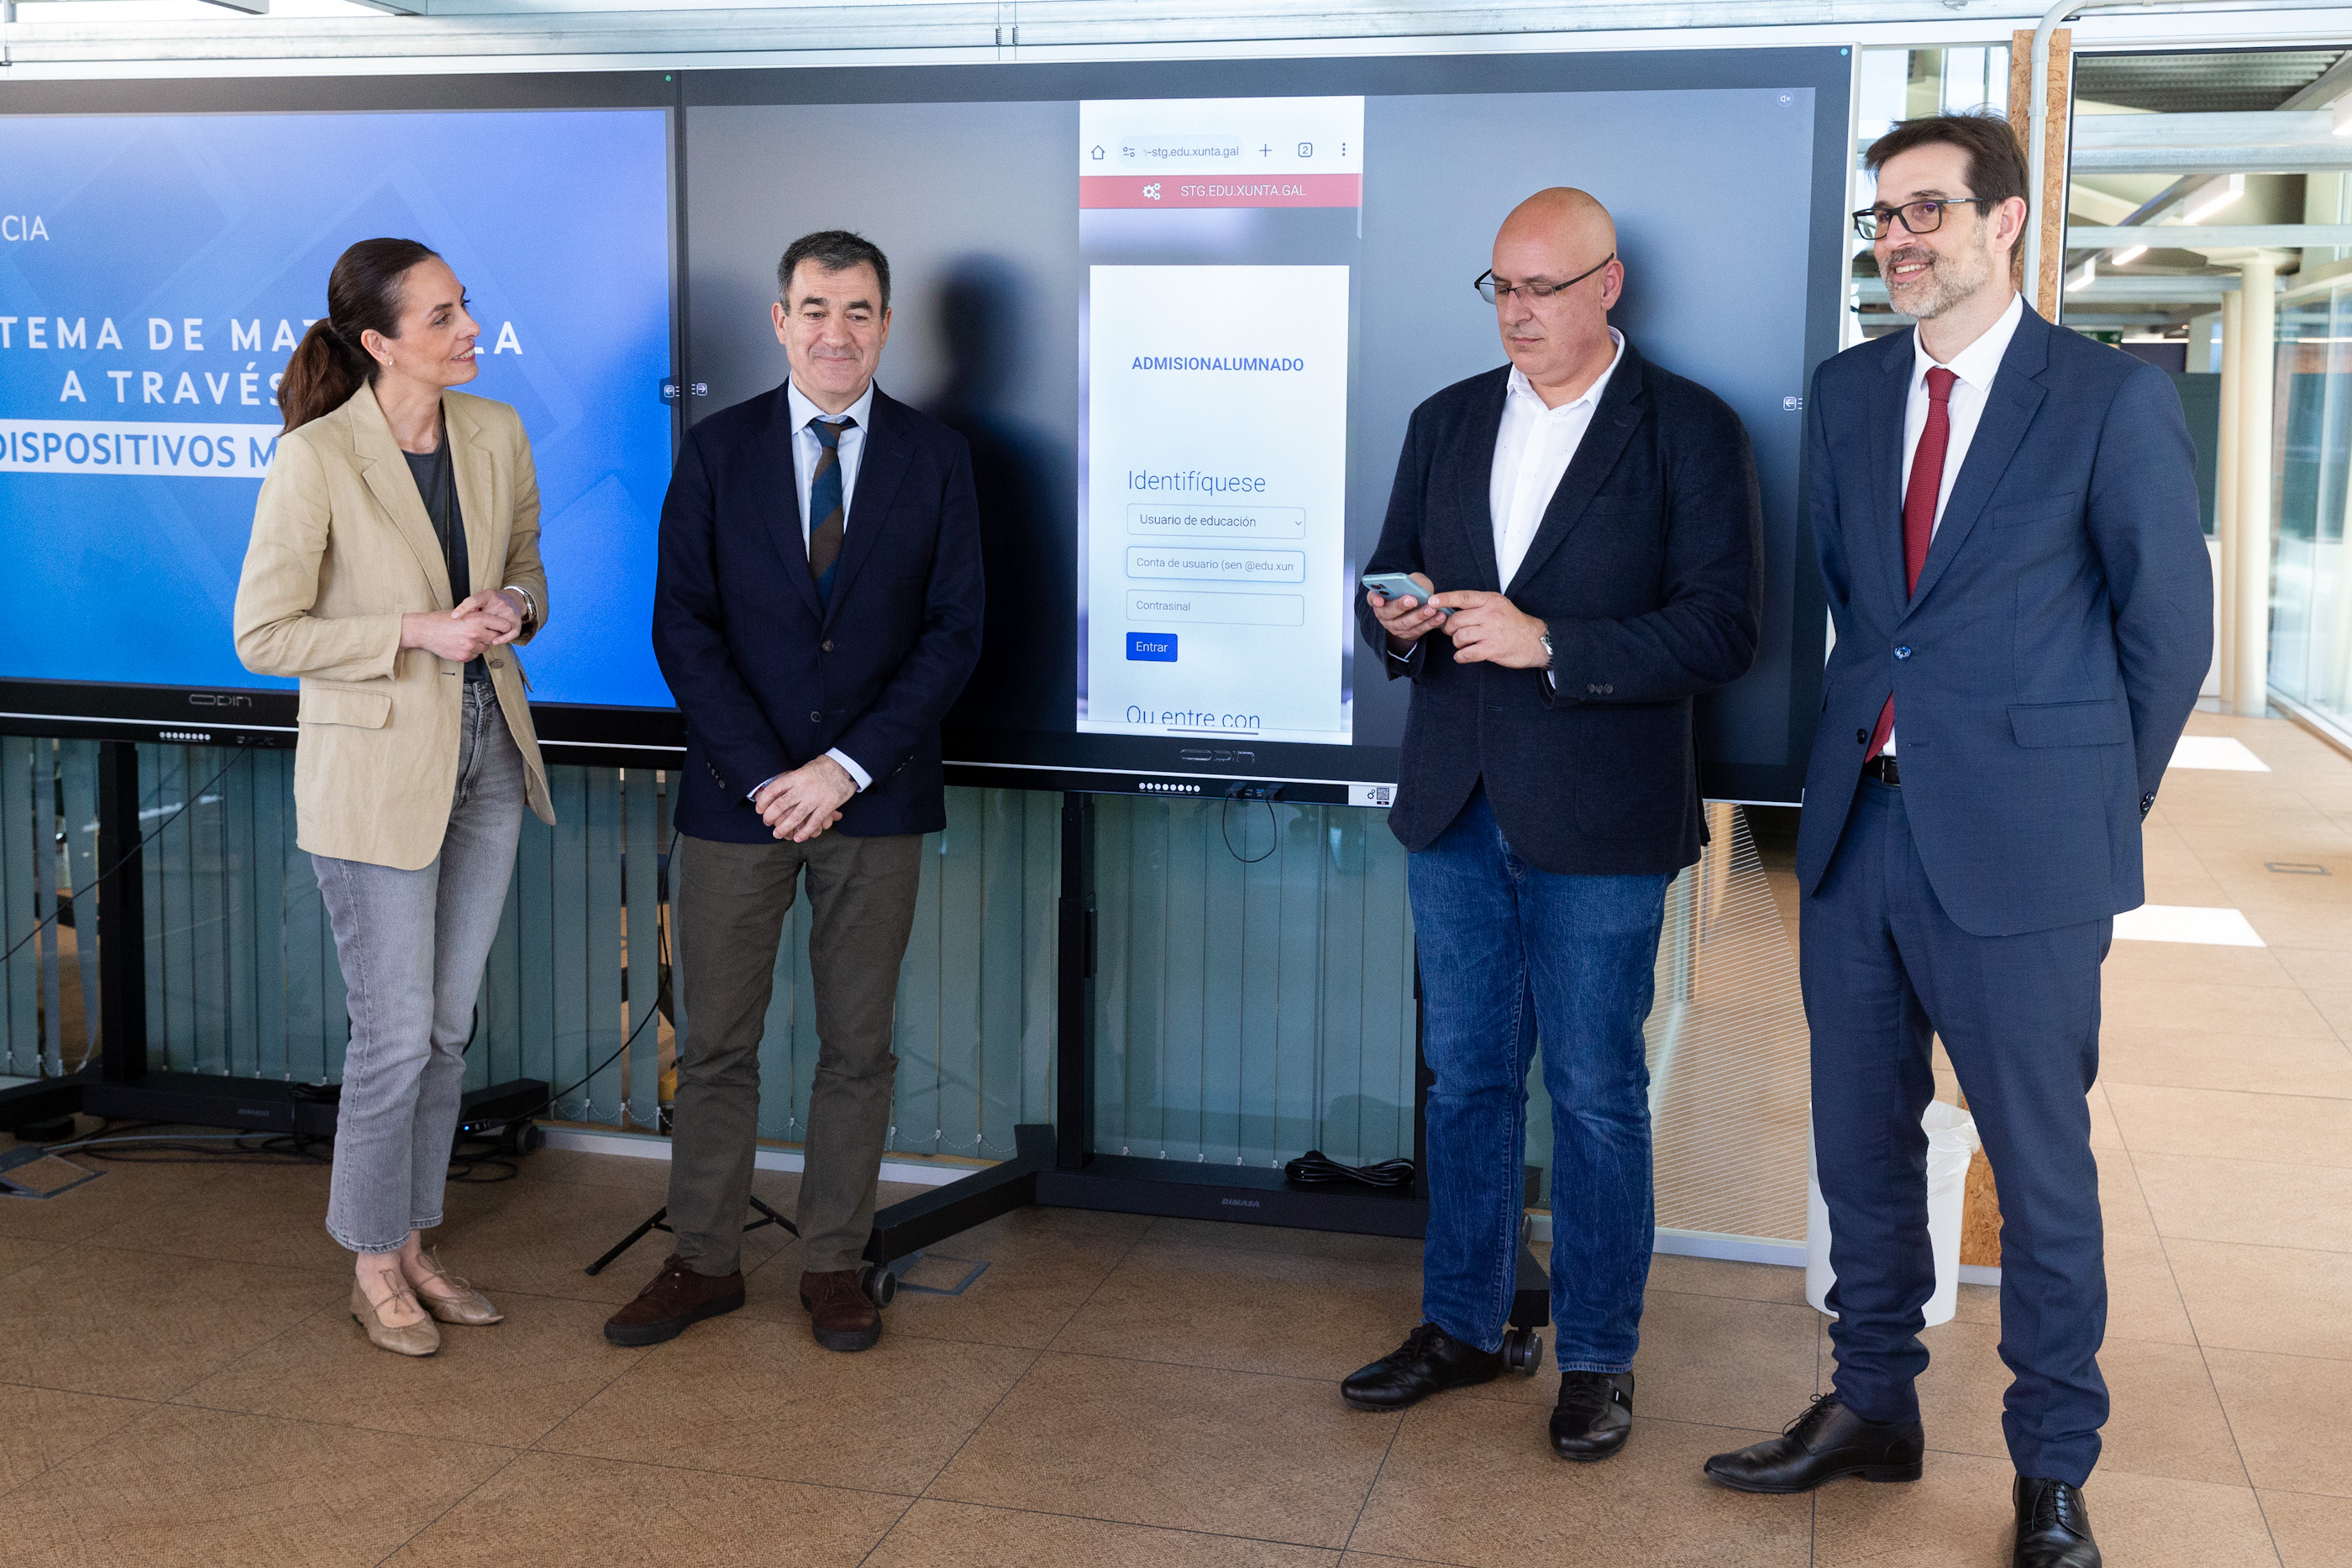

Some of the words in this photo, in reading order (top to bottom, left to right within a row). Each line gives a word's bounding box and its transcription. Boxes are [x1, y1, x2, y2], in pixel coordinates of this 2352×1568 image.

[1180, 184, 1307, 197] STG.EDU.XUNTA.GAL
[2, 215, 50, 241] CIA
[148, 317, 205, 351] DE
[1131, 356, 1305, 372] ADMISIONALUMNADO
[60, 370, 87, 403] A
[1128, 469, 1266, 496] Identifíquese
[1140, 514, 1181, 525] Usuario
[1184, 515, 1198, 526] de
[1200, 515, 1257, 527] educación
[1137, 558, 1165, 568] Conta
[1168, 558, 1180, 568] de
[1182, 559, 1219, 569] usuario
[1221, 559, 1242, 572] (sen
[1244, 560, 1295, 573] @edu.xun
[1136, 600, 1191, 611] Contrasinal
[1136, 641, 1168, 653] Entrar
[1161, 709, 1215, 726] entre
[1221, 714, 1261, 728] con
